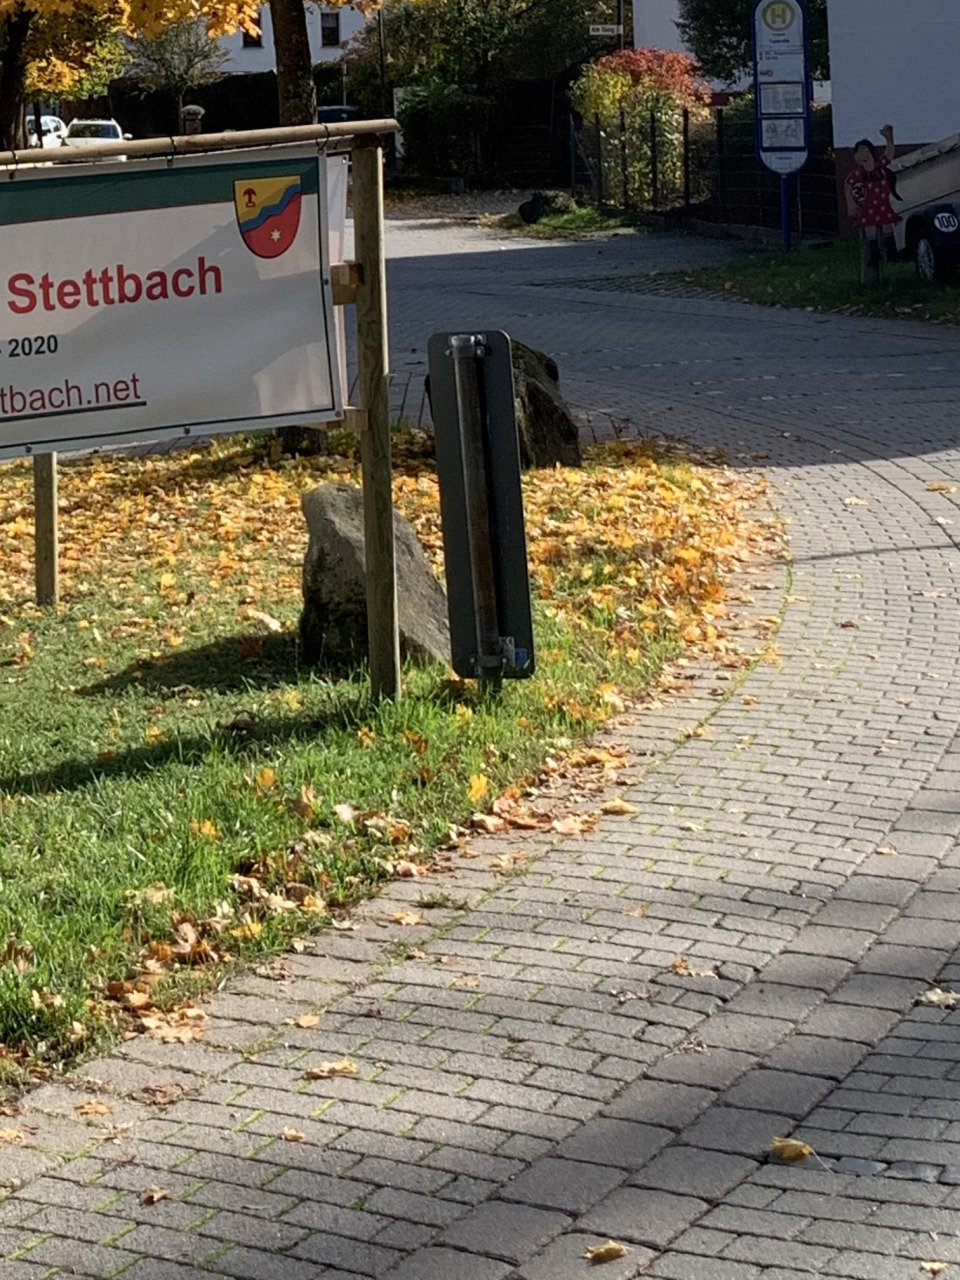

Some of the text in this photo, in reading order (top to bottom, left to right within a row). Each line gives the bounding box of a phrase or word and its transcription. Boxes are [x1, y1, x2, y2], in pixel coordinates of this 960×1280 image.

[770, 7, 787, 25] H
[936, 215, 957, 229] 100
[7, 256, 223, 314] Stettbach
[8, 334, 59, 358] 2020
